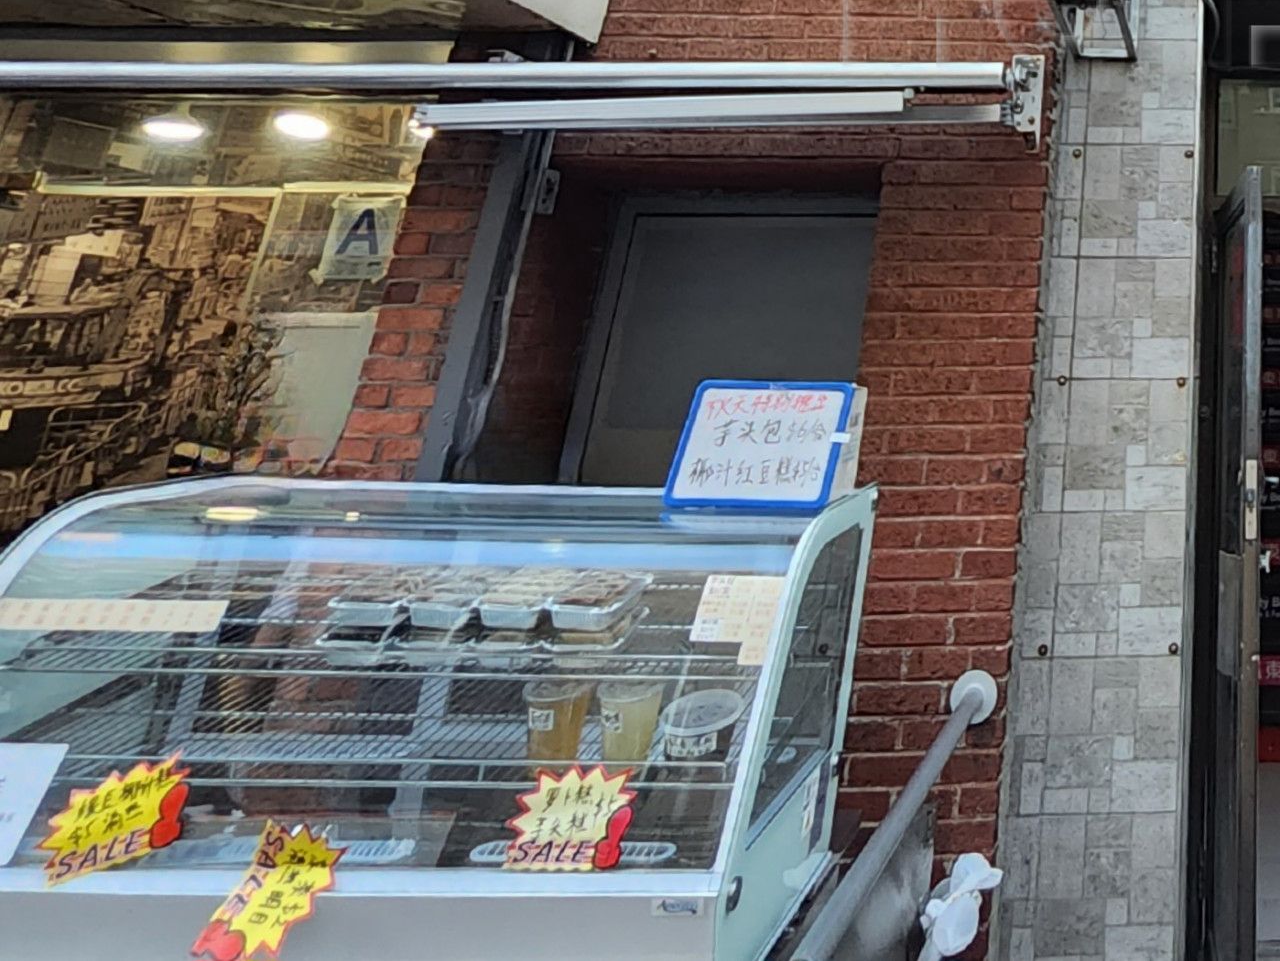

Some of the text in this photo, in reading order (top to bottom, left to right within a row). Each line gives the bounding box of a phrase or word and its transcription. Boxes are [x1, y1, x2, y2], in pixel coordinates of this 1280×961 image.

[335, 207, 379, 256] A
[56, 827, 147, 878] SALE
[512, 841, 594, 864] SALE
